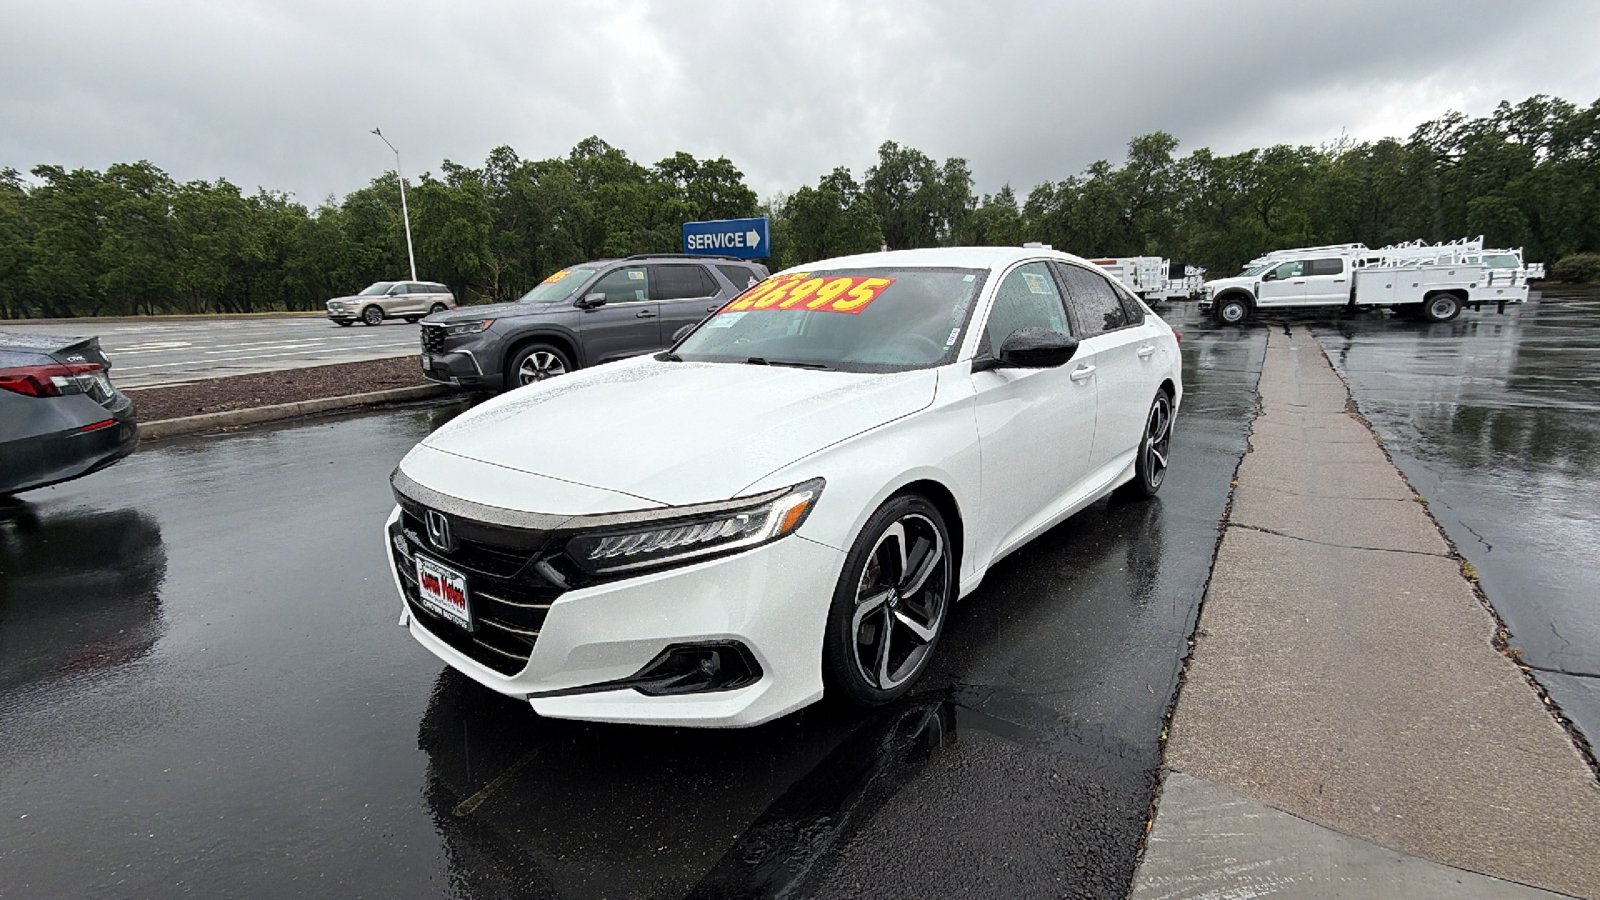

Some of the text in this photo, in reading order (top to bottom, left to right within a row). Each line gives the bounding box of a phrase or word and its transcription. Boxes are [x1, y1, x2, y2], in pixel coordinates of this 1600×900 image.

[687, 231, 744, 250] SERVICE
[730, 277, 891, 311] 26995
[422, 599, 443, 616] CROWN
[442, 609, 468, 629] MOTORS
